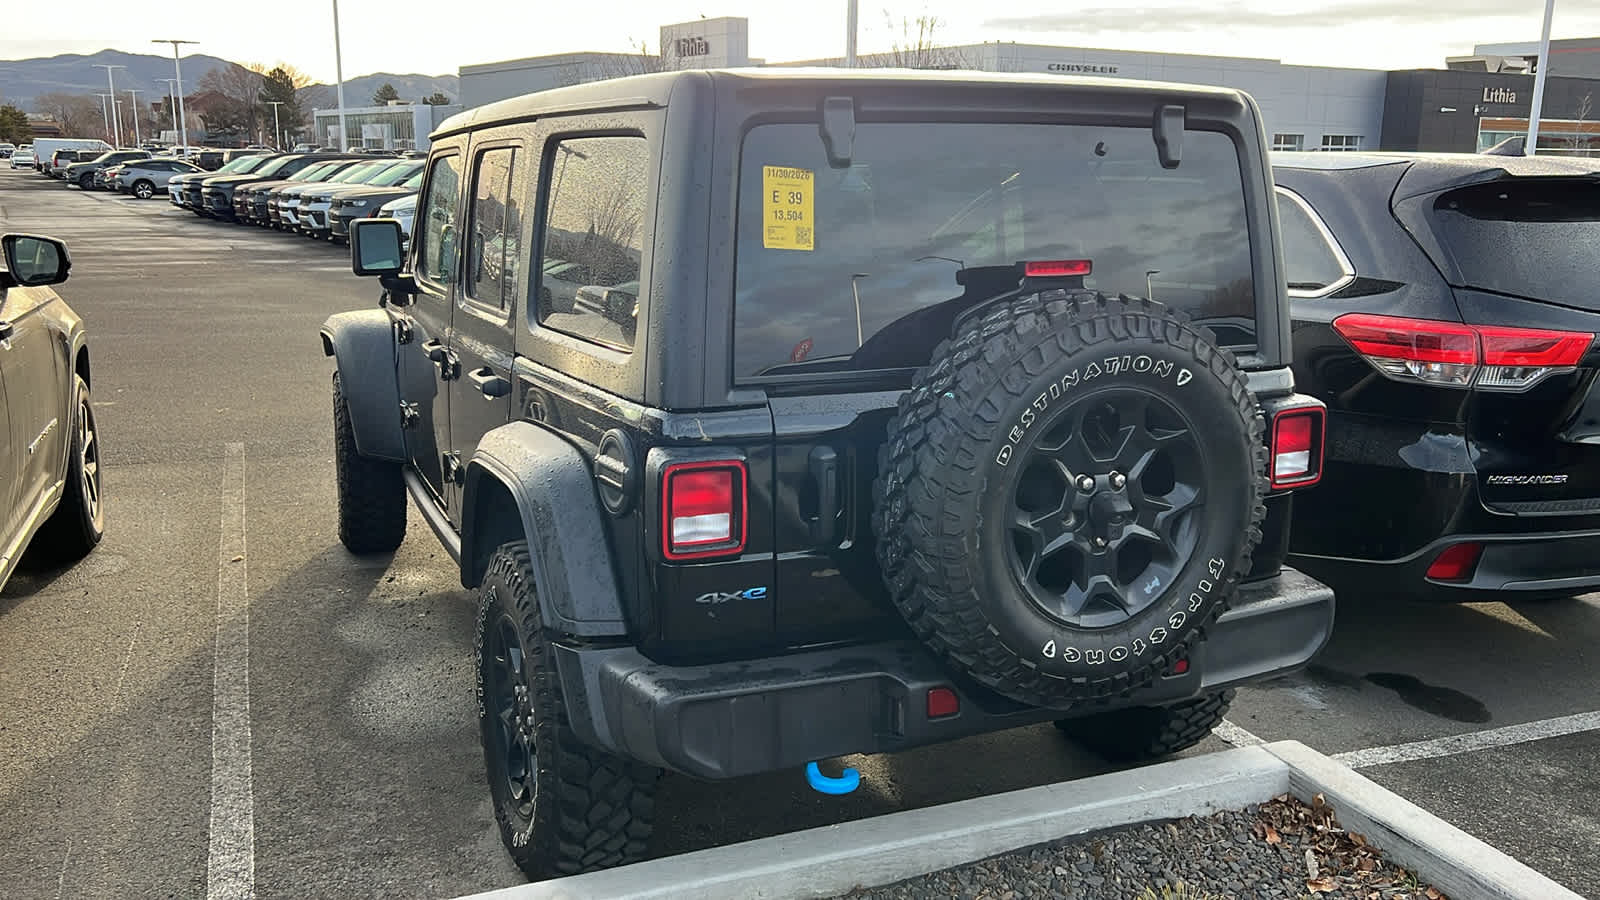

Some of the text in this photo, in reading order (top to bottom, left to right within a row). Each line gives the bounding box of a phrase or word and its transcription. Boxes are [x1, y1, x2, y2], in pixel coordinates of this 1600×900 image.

[675, 37, 710, 57] Lithia
[1047, 63, 1120, 74] CHRYSLER
[1482, 87, 1517, 103] Lithia
[773, 190, 802, 205] E 39
[996, 355, 1174, 466] DESTINATION
[1487, 473, 1569, 485] HIGHLANDER
[1063, 558, 1225, 665] Firestone
